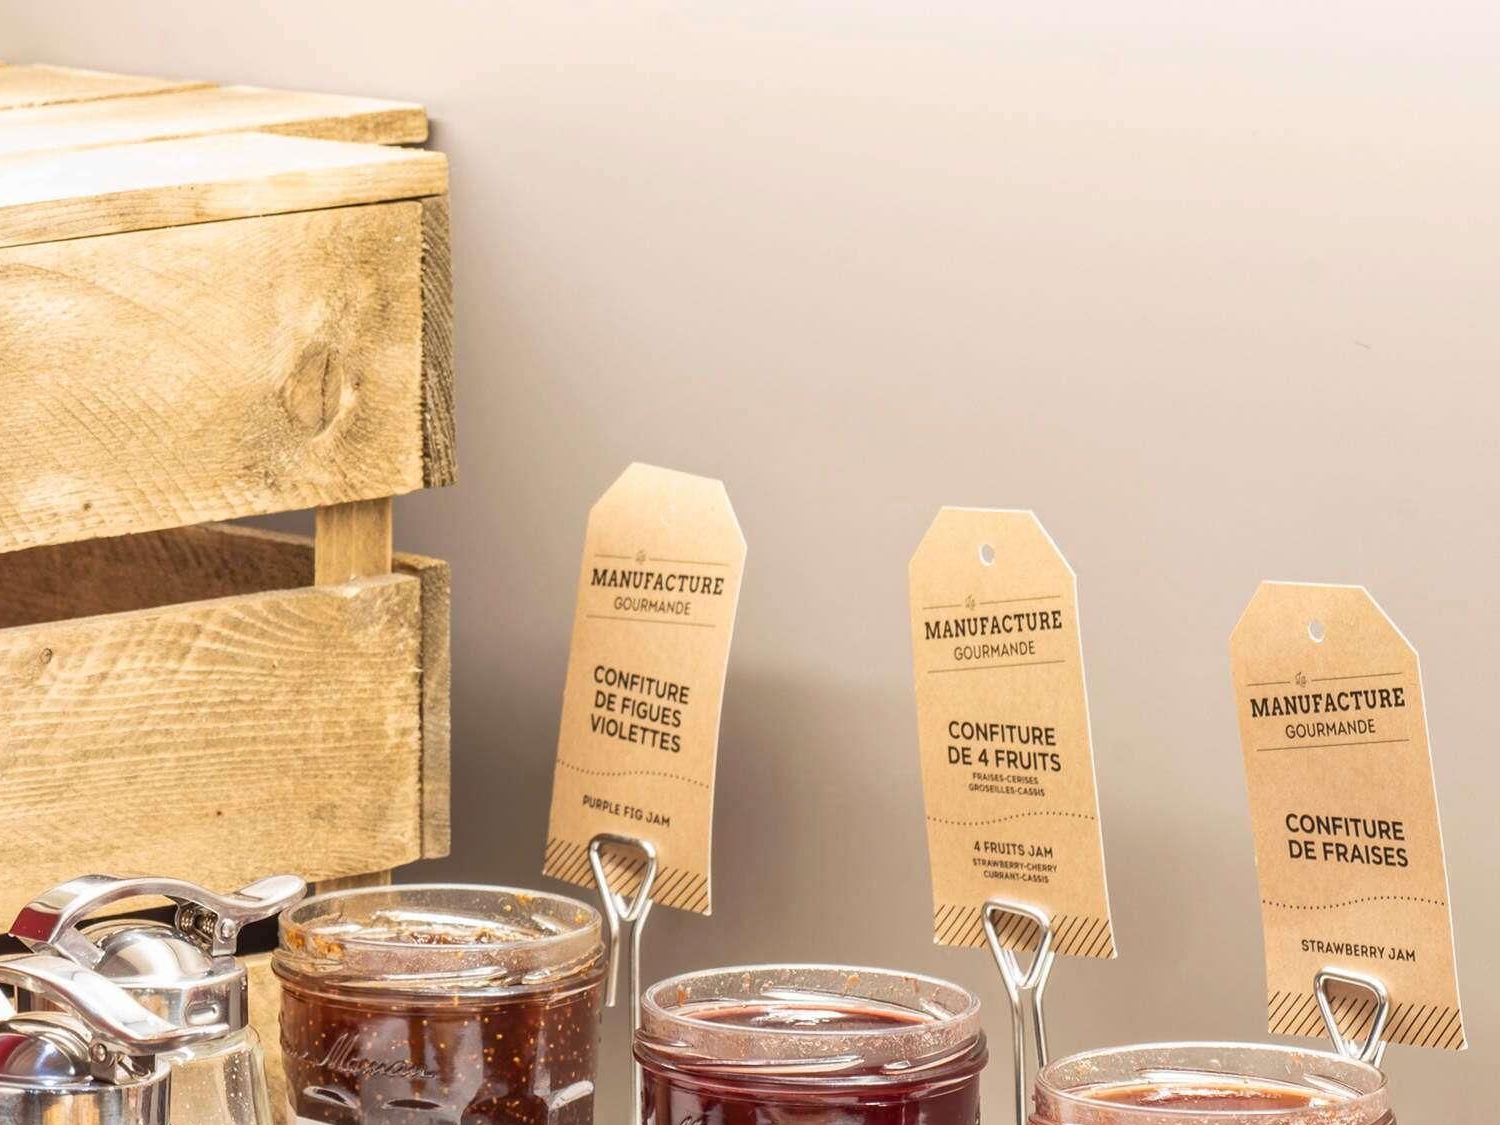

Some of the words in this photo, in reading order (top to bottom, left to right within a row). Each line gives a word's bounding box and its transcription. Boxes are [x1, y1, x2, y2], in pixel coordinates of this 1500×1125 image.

[591, 568, 724, 595] MANUFACTURE
[613, 596, 691, 616] GOURMANDE
[924, 610, 1062, 640] MANUFACTURE
[953, 640, 1036, 661] GOURMANDE
[593, 665, 690, 705] CONFITURE
[594, 690, 617, 712] DE
[620, 697, 682, 728] FIGUES
[1250, 687, 1405, 717] MANUFACTURE
[590, 713, 681, 753] VIOLETTES
[948, 720, 1056, 746] CONFITURE
[1285, 718, 1376, 739] GOURMANDE
[948, 746, 973, 766] DE
[978, 748, 989, 767] 4
[995, 749, 1061, 772] FRUITS
[582, 794, 621, 817] PURPLE
[623, 806, 644, 821] FIG
[645, 812, 670, 828] JAM
[1285, 813, 1405, 841] CONFITURE
[974, 840, 981, 852] 4
[983, 841, 1026, 857] FRUITS
[1028, 845, 1053, 859] JAM
[1288, 839, 1317, 860] DE
[1322, 841, 1409, 868] FRAISES
[1301, 939, 1385, 959] STRAWBERRY
[1388, 948, 1416, 963] JAM
